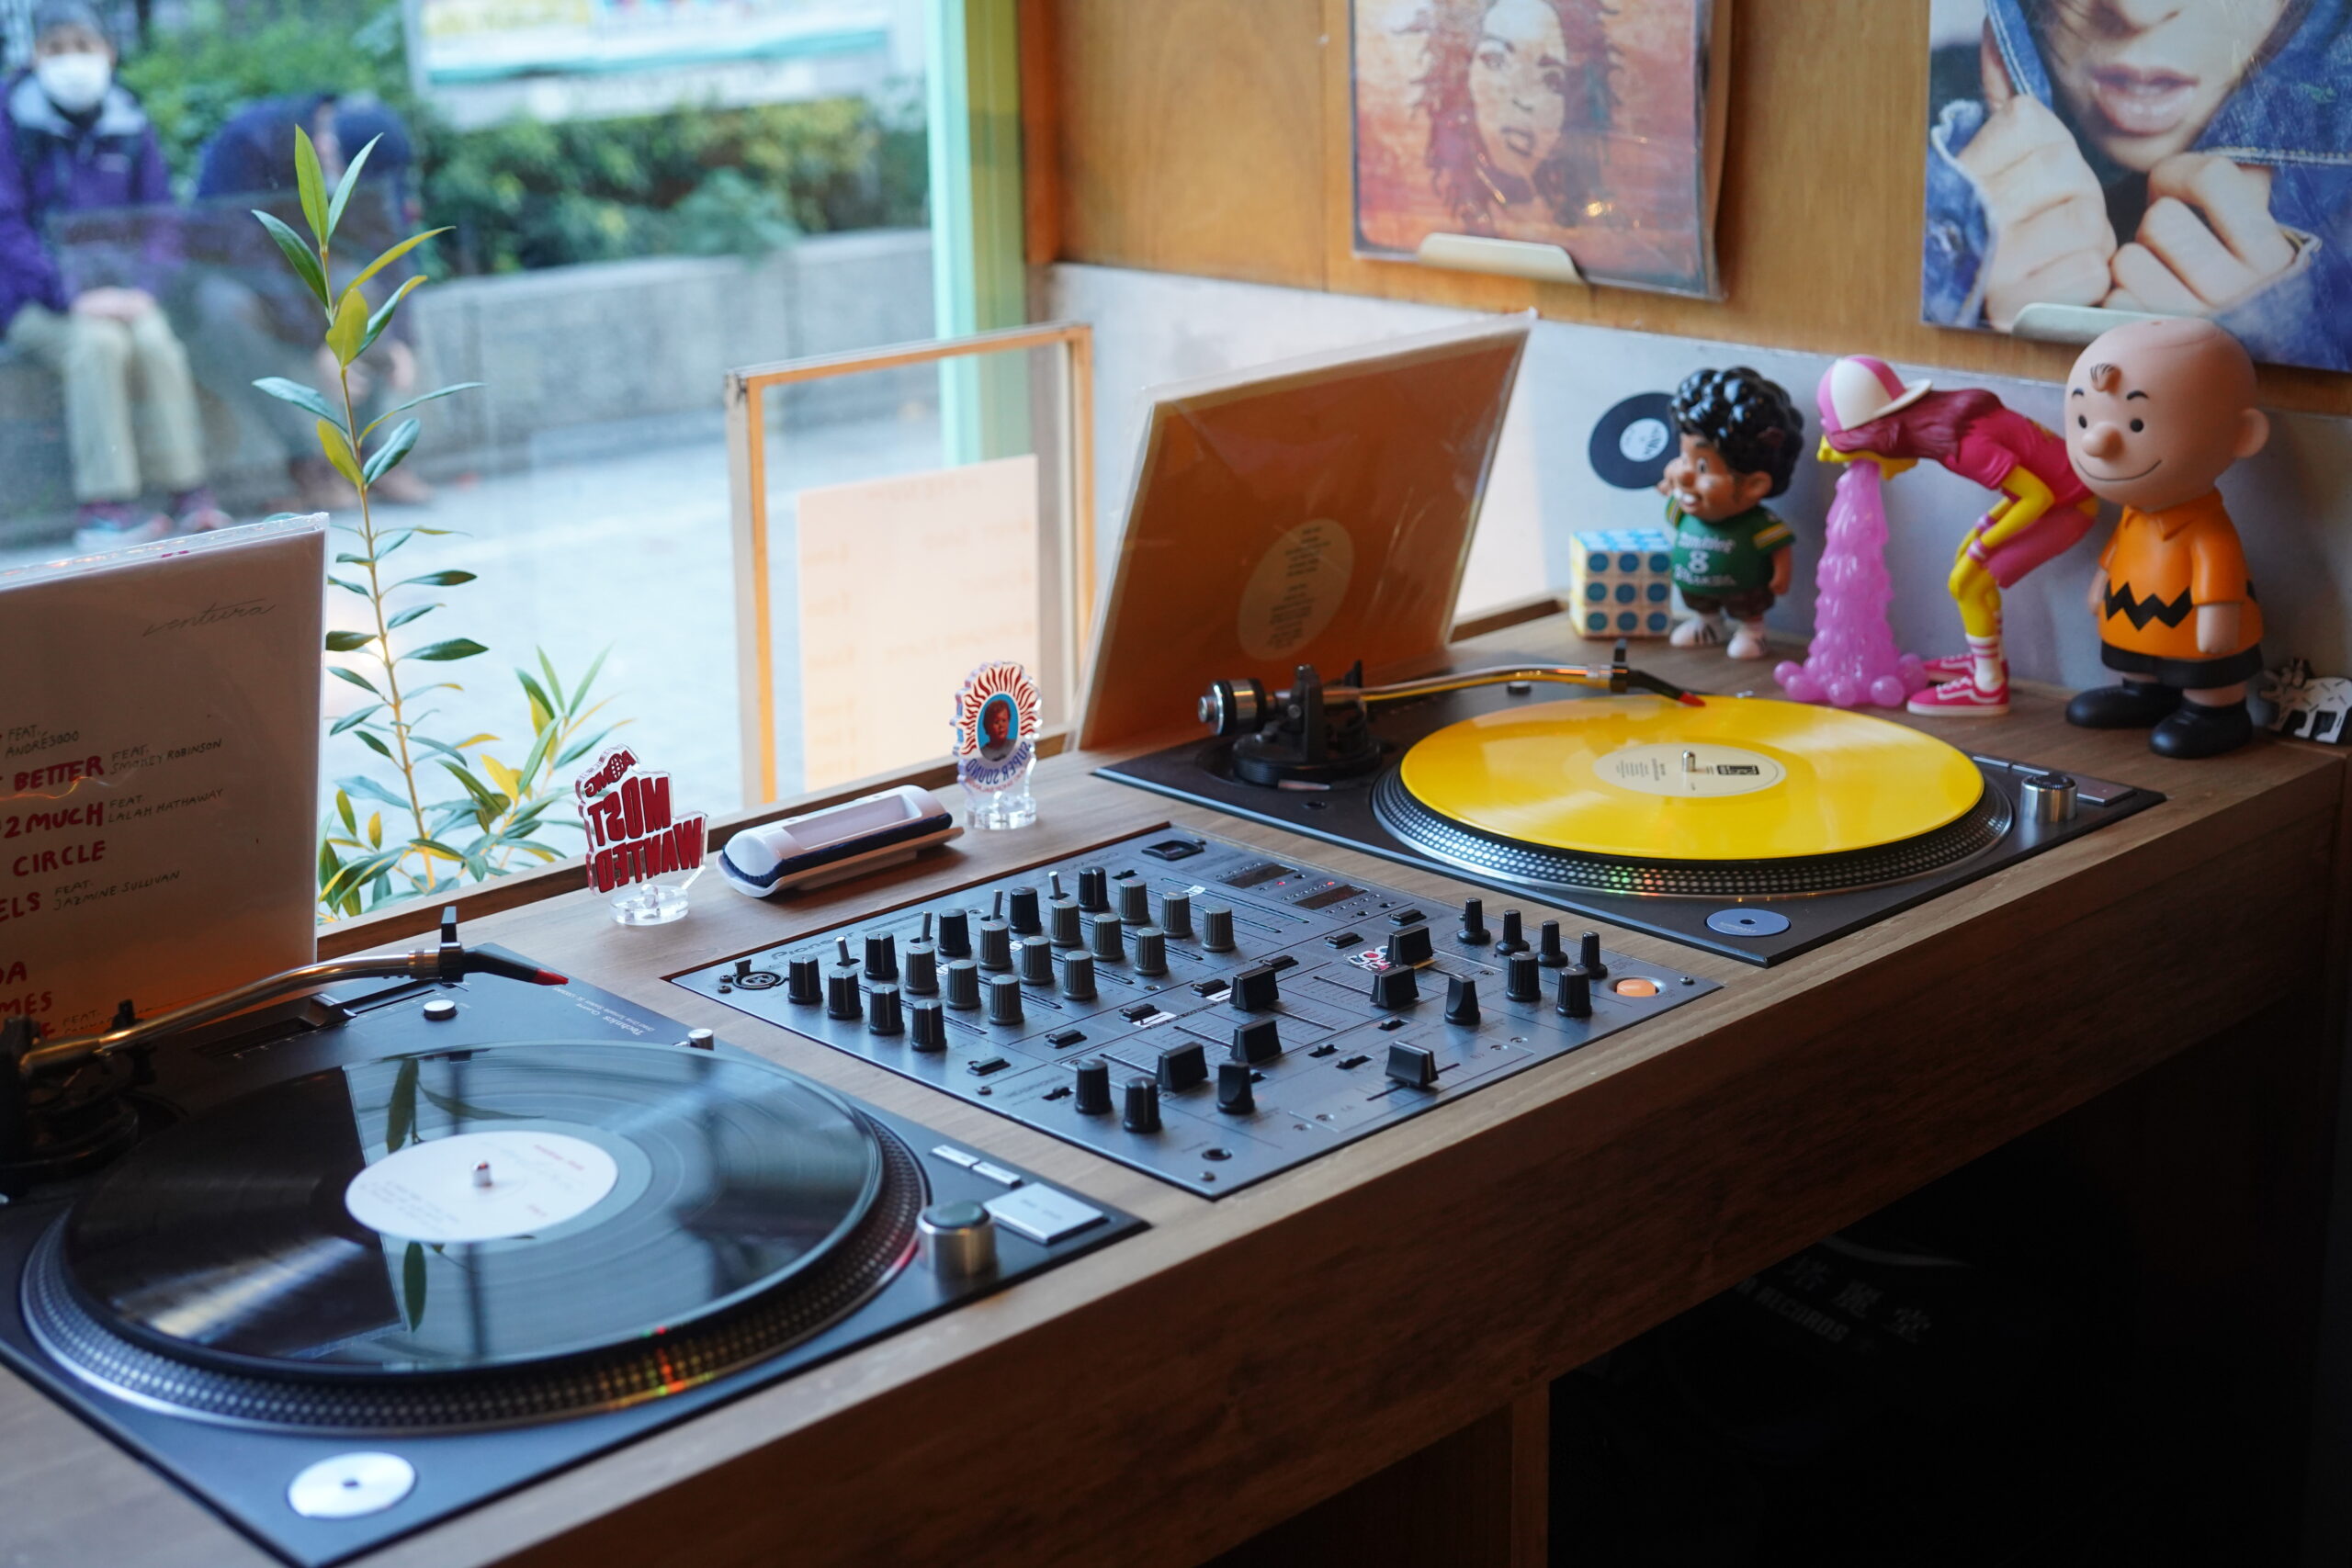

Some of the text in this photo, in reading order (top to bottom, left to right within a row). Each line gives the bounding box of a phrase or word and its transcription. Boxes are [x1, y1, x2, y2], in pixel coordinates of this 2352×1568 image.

[1688, 550, 1710, 574] 8
[141, 597, 277, 638] ventura
[166, 739, 223, 762] ROBINSON
[14, 755, 105, 792] BETTER
[108, 788, 224, 823] LALAH HATHAWAY
[13, 840, 107, 877] CIRCLE
[52, 870, 181, 911] JAZMINE SULLIVAN
[771, 931, 854, 961] Pioner
[1754, 1285, 1851, 1345] RECORDS
